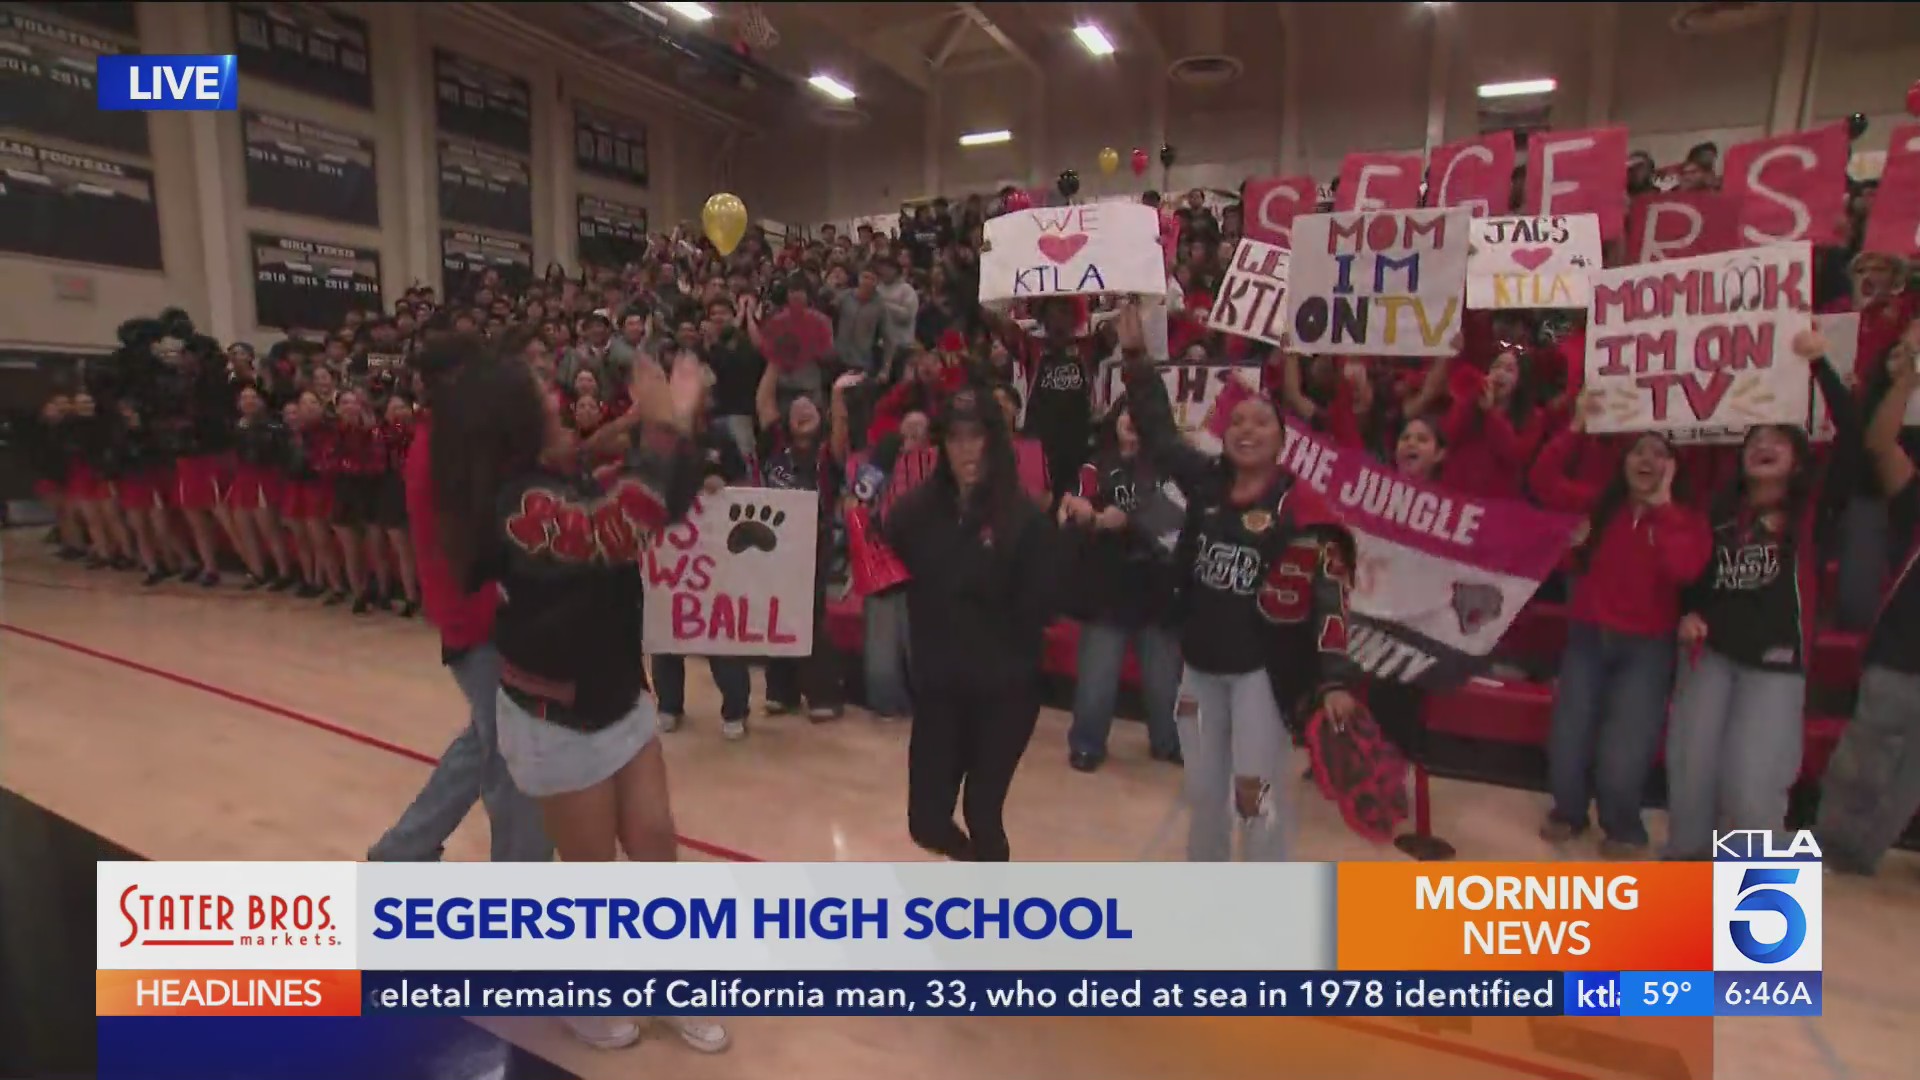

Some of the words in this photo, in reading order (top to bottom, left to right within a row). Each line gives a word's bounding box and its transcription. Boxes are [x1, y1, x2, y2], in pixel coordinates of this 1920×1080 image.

[1031, 207, 1100, 232] WE
[1327, 213, 1446, 254] MOM
[1483, 215, 1570, 244] JAGS
[1013, 264, 1106, 294] KTLA
[1492, 272, 1573, 305] KTLA
[1214, 276, 1286, 340] KTL
[1295, 297, 1370, 344] ON
[1375, 296, 1458, 346] TV
[1595, 329, 1677, 376] IM
[1694, 321, 1776, 372] ON
[1635, 370, 1736, 421] TV
[1275, 425, 1338, 494] THE
[1340, 465, 1486, 546] JUNGLE
[639, 550, 717, 591] WS
[671, 591, 798, 645] BALL
